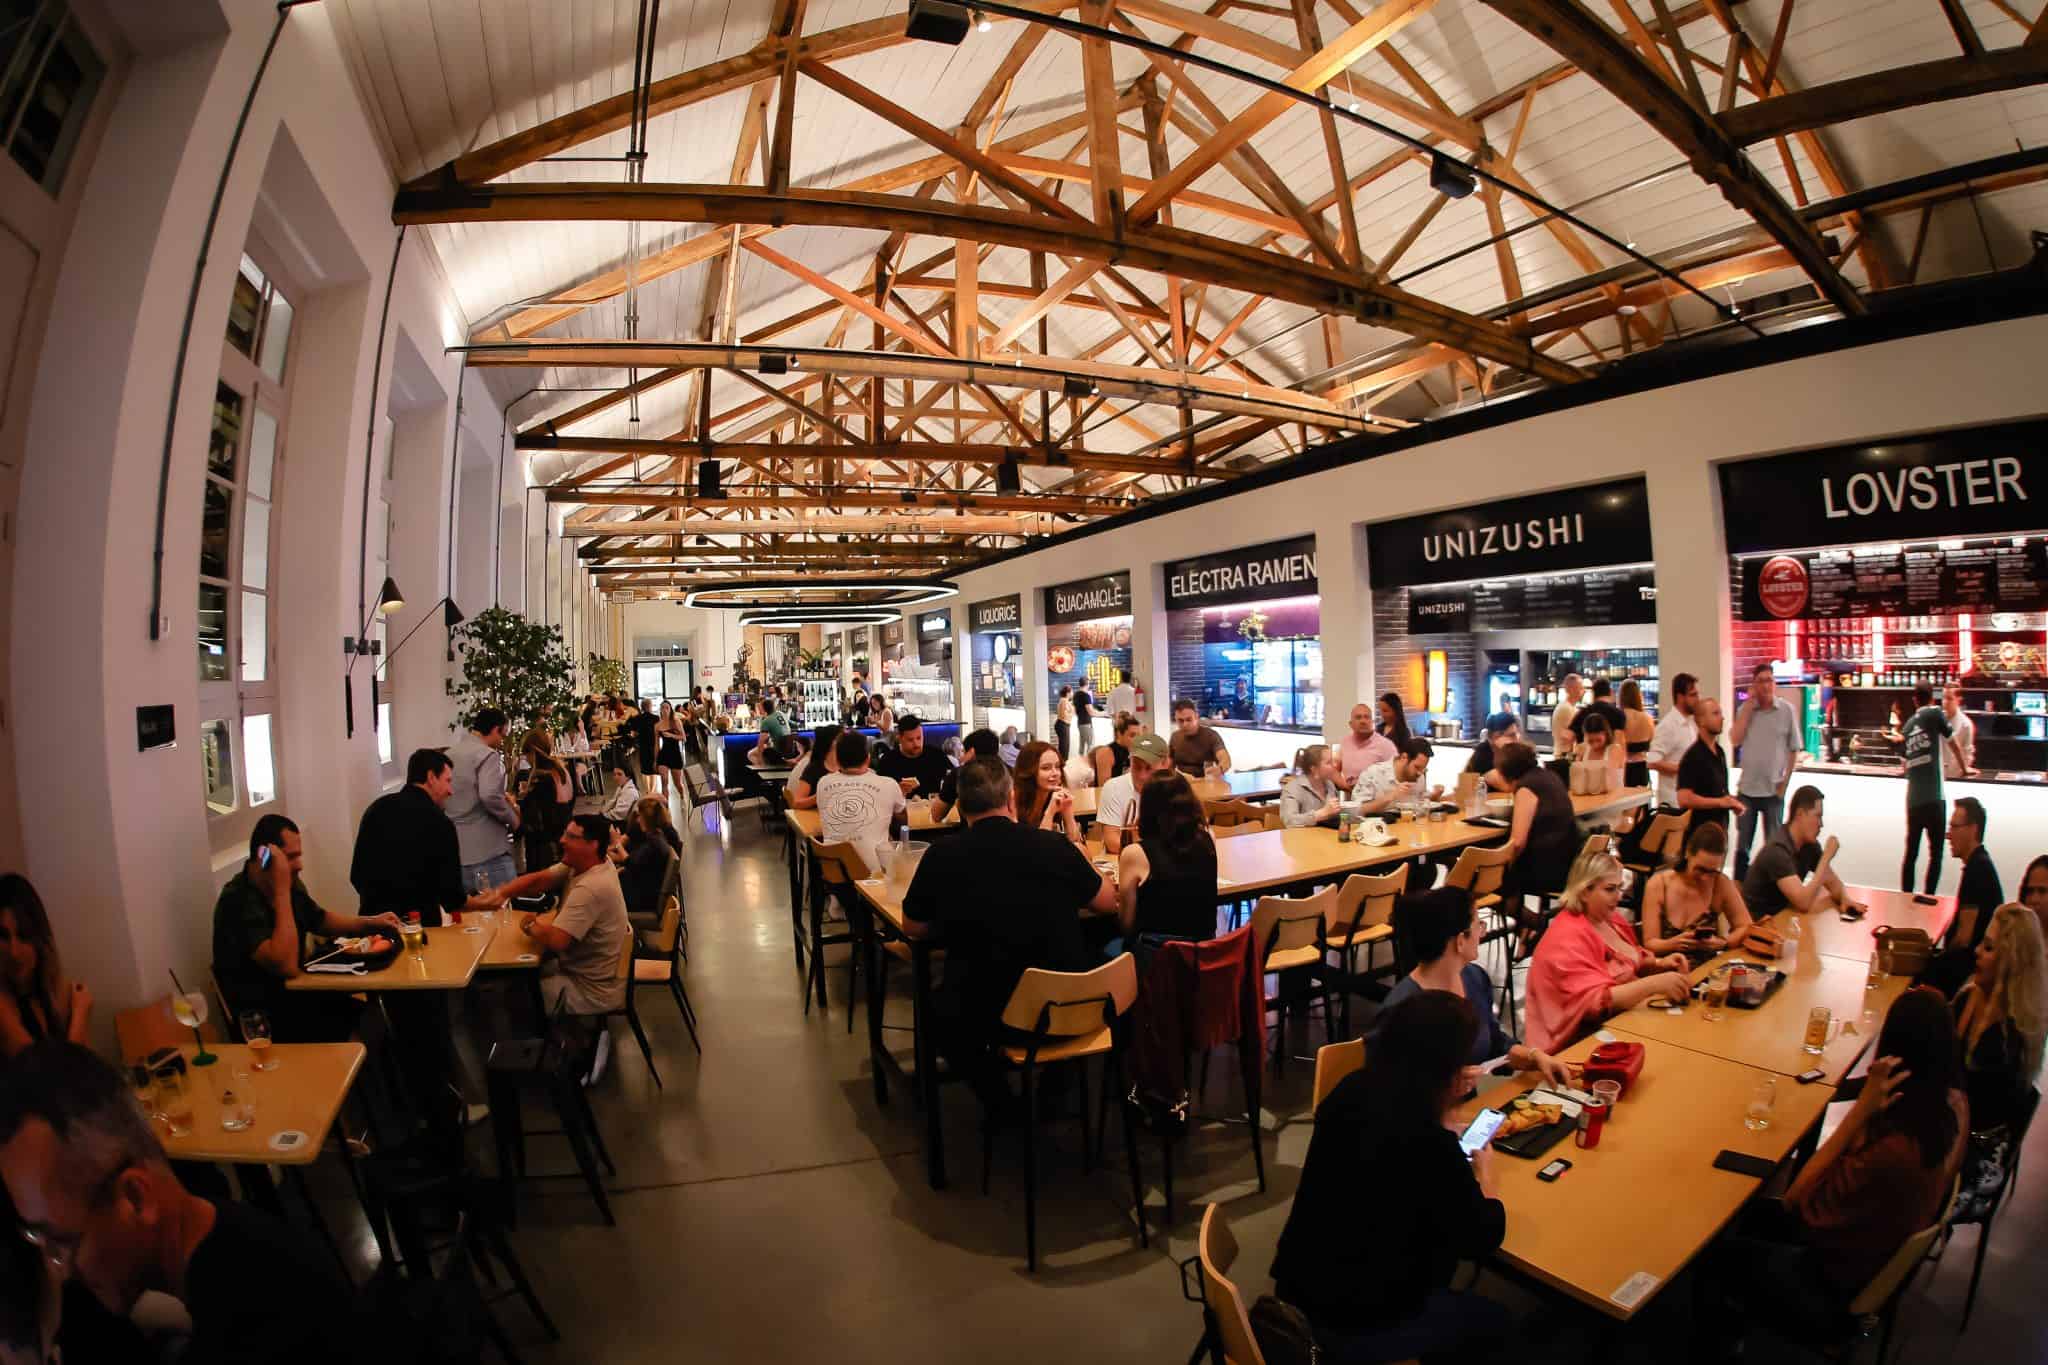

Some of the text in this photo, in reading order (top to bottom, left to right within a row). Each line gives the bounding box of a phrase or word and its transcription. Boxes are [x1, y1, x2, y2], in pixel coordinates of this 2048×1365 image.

[1822, 457, 2028, 518] LOVSTER
[1423, 513, 1584, 562] UNIZUSHI
[1171, 552, 1318, 598] ELECTRA RAMEN
[979, 604, 1017, 625] LIQUORICE
[1055, 587, 1124, 614] GUACAMOLE
[1418, 602, 1465, 615] UNIZUSHI
